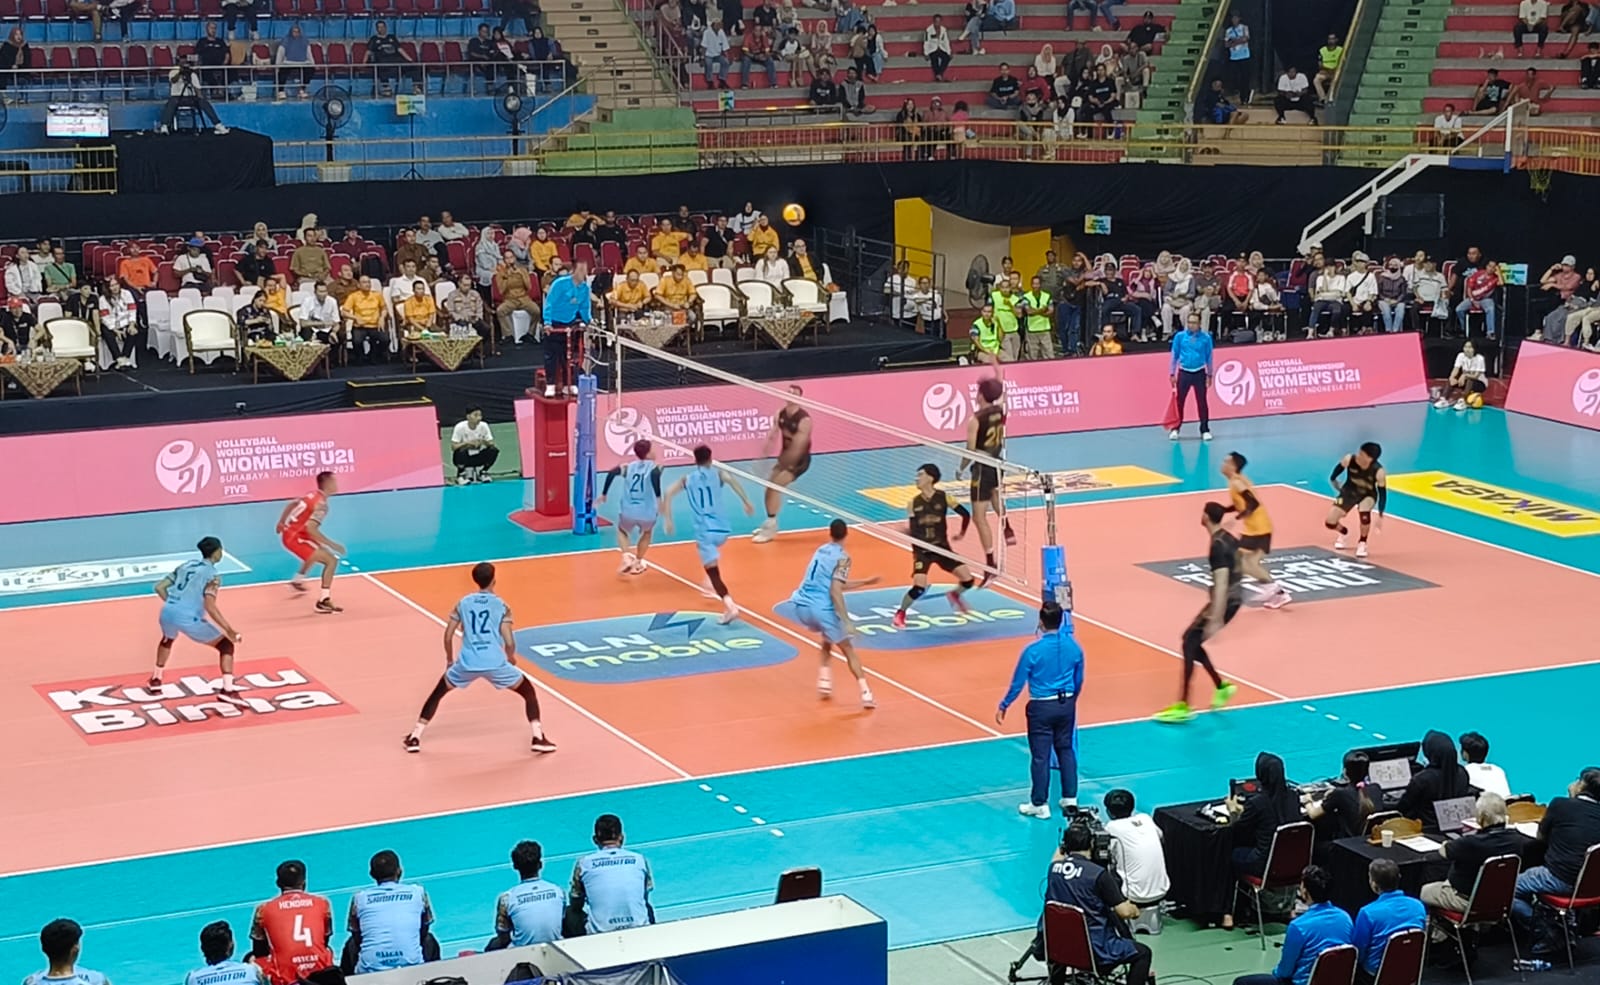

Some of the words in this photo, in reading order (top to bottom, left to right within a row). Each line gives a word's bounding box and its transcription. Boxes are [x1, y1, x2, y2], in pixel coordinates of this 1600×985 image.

[1257, 358, 1303, 368] VOLLEYBALL
[1260, 372, 1332, 389] WOMEN'S
[656, 404, 709, 416] VOLLEYBALL
[657, 414, 688, 424] WORLD
[658, 418, 742, 438] WOMEN'S
[216, 436, 278, 448] VOLLEYBALL
[216, 447, 254, 458] WORLD
[255, 441, 335, 454] CHAMPIONSHIP
[218, 450, 316, 474] WOMEN'S
[220, 472, 270, 484] SURABAYA
[630, 473, 645, 492] 21
[699, 486, 713, 508] 11
[1432, 480, 1599, 522] MIKASA
[178, 570, 196, 590] 5
[470, 610, 490, 634] 12
[848, 605, 920, 621] LN
[530, 633, 654, 657] PLN
[556, 638, 764, 670] mobile
[48, 668, 309, 712] Kuku
[71, 690, 344, 734] Bima
[294, 914, 312, 947] 4
